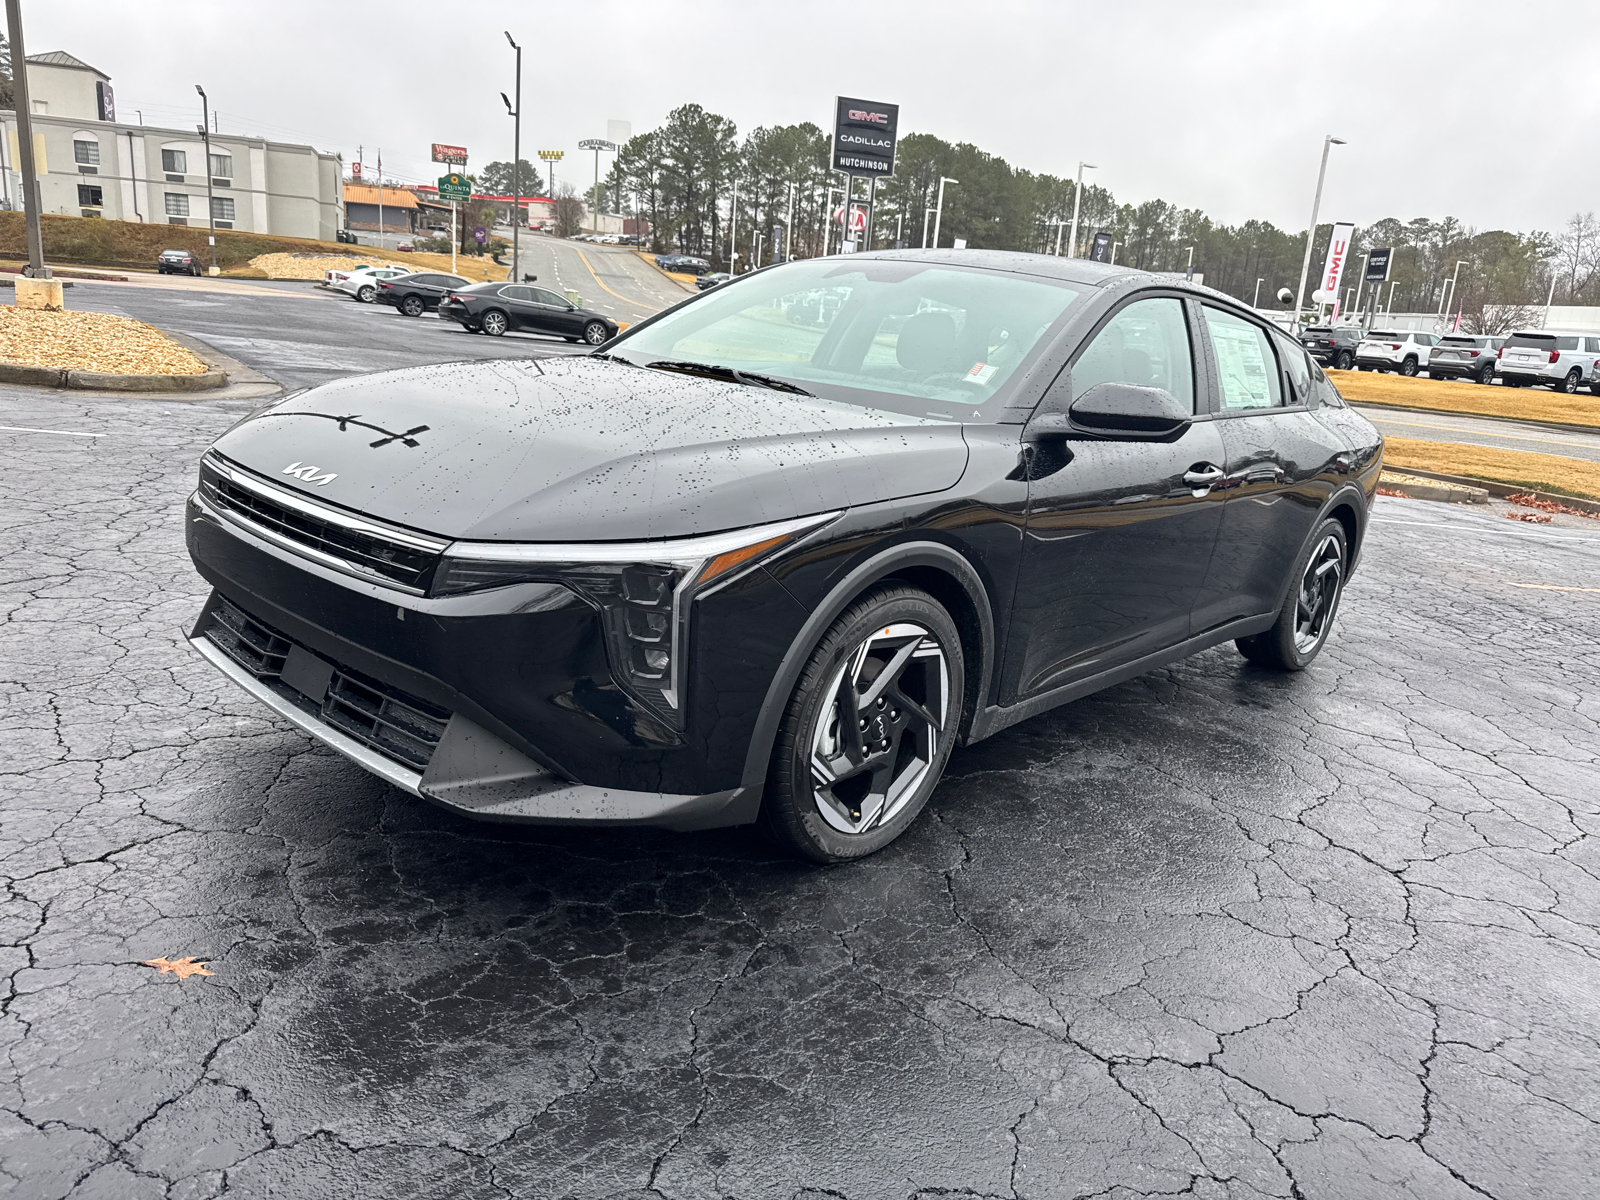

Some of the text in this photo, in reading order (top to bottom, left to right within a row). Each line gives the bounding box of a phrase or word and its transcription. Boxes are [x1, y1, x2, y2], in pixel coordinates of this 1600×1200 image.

[848, 109, 888, 124] GMC
[840, 134, 892, 148] CADILLAC
[840, 156, 889, 171] HUTCHINSON
[1326, 240, 1346, 291] GMC
[281, 461, 339, 487] KIA
